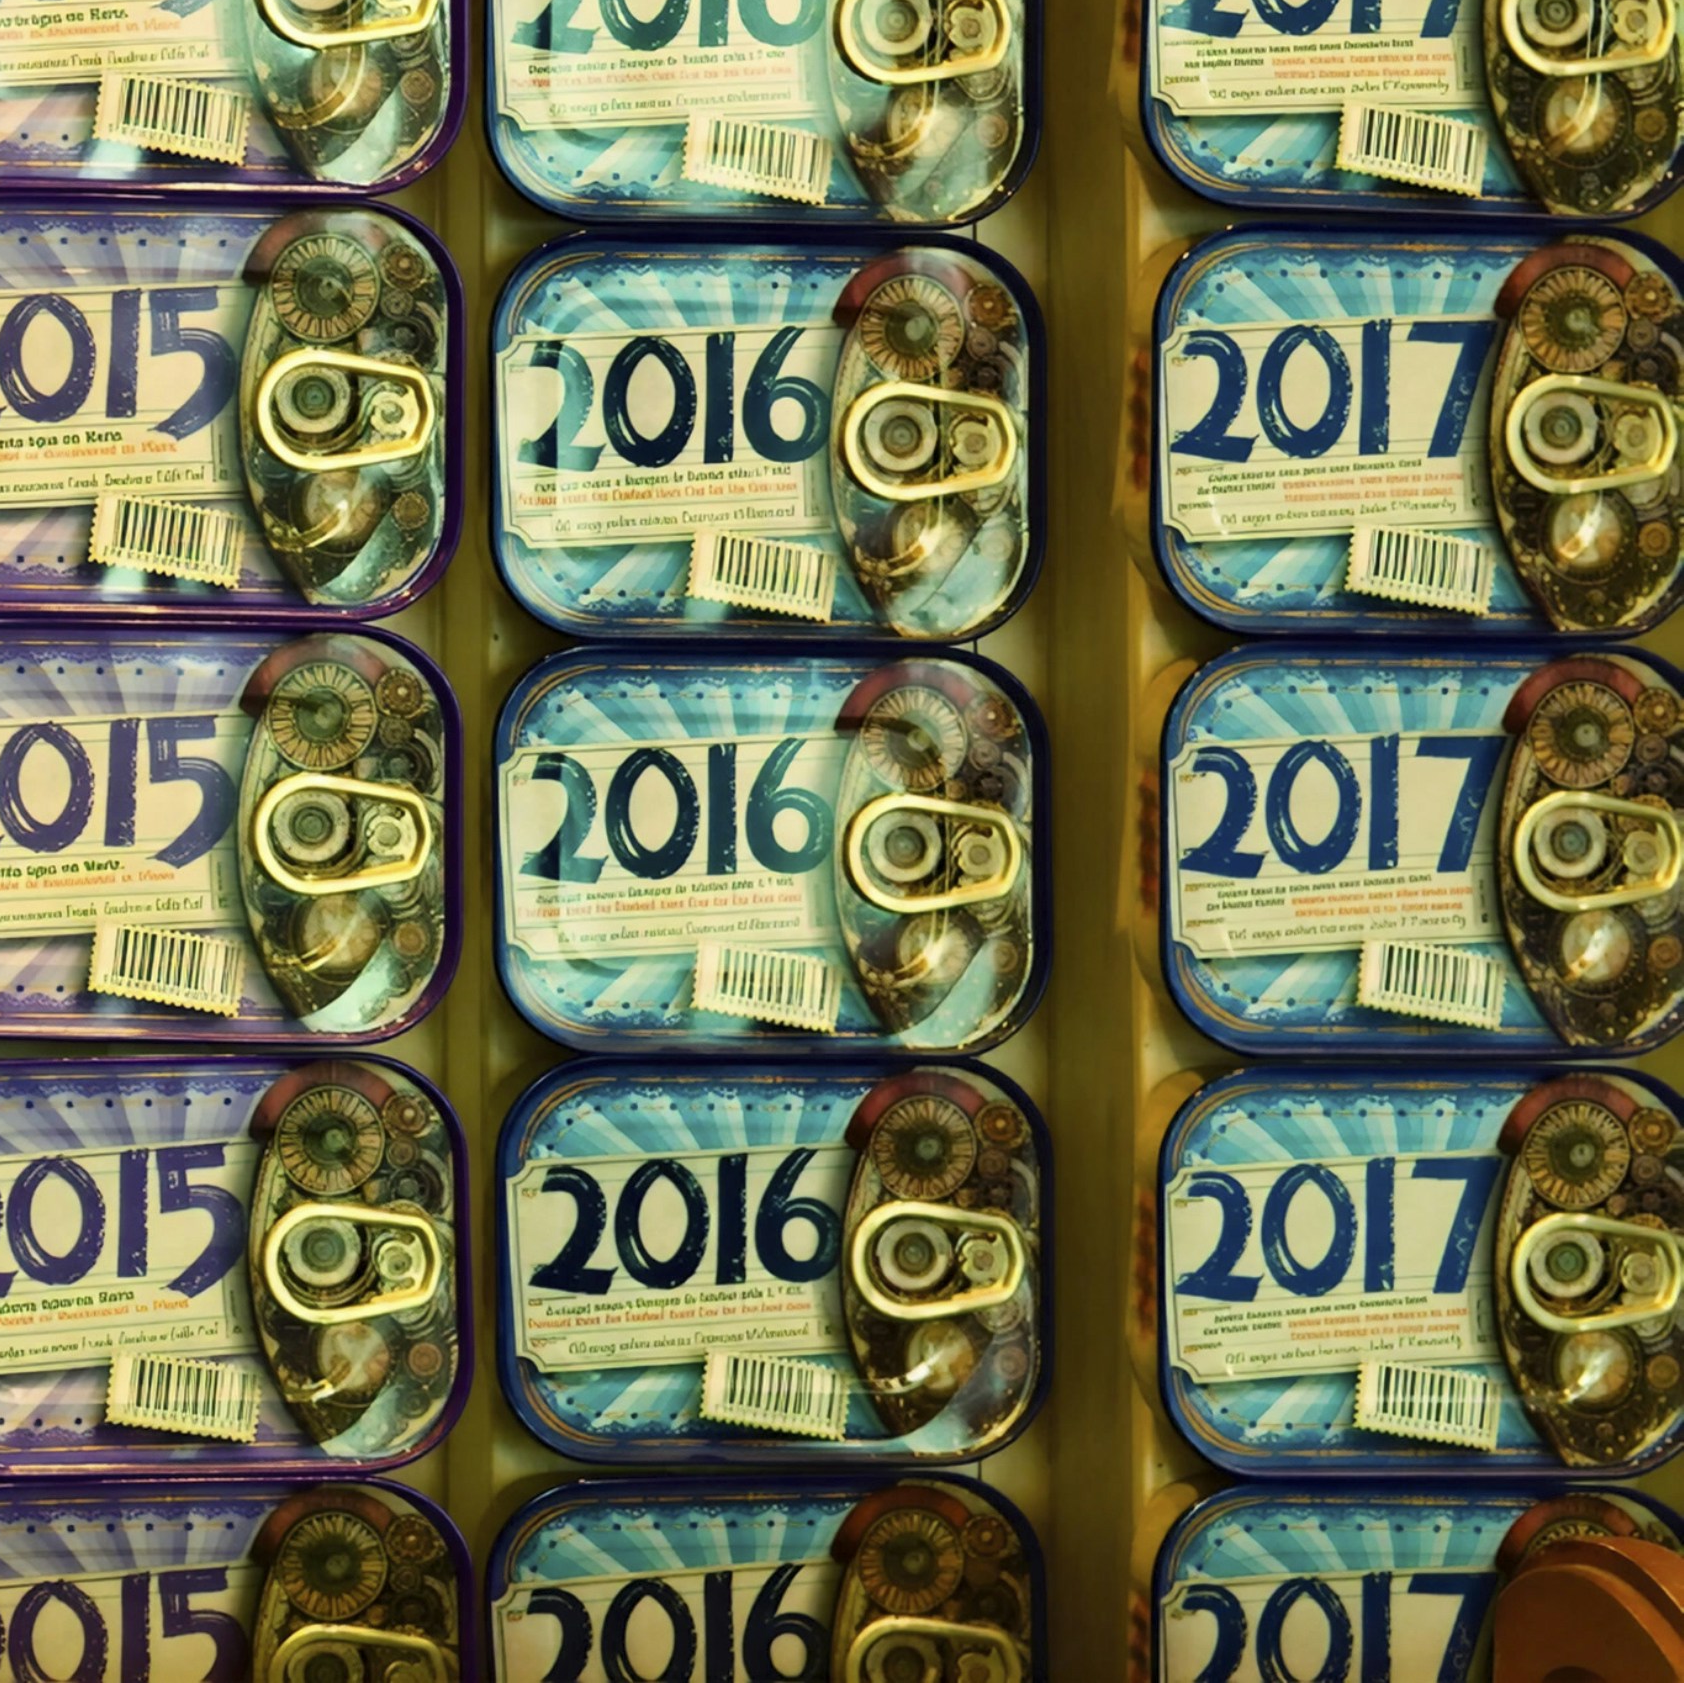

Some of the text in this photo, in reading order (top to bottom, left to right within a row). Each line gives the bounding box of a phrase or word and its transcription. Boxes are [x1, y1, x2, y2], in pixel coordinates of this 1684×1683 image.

[512, 326, 831, 471] 2016
[1168, 319, 1499, 461] 2017
[521, 736, 833, 882] 2016
[1181, 734, 1504, 878] 2017
[532, 1148, 844, 1296] 2016
[1177, 1155, 1497, 1301] 2017
[521, 1562, 835, 1683] 2016
[1176, 1570, 1499, 1683] 2017
